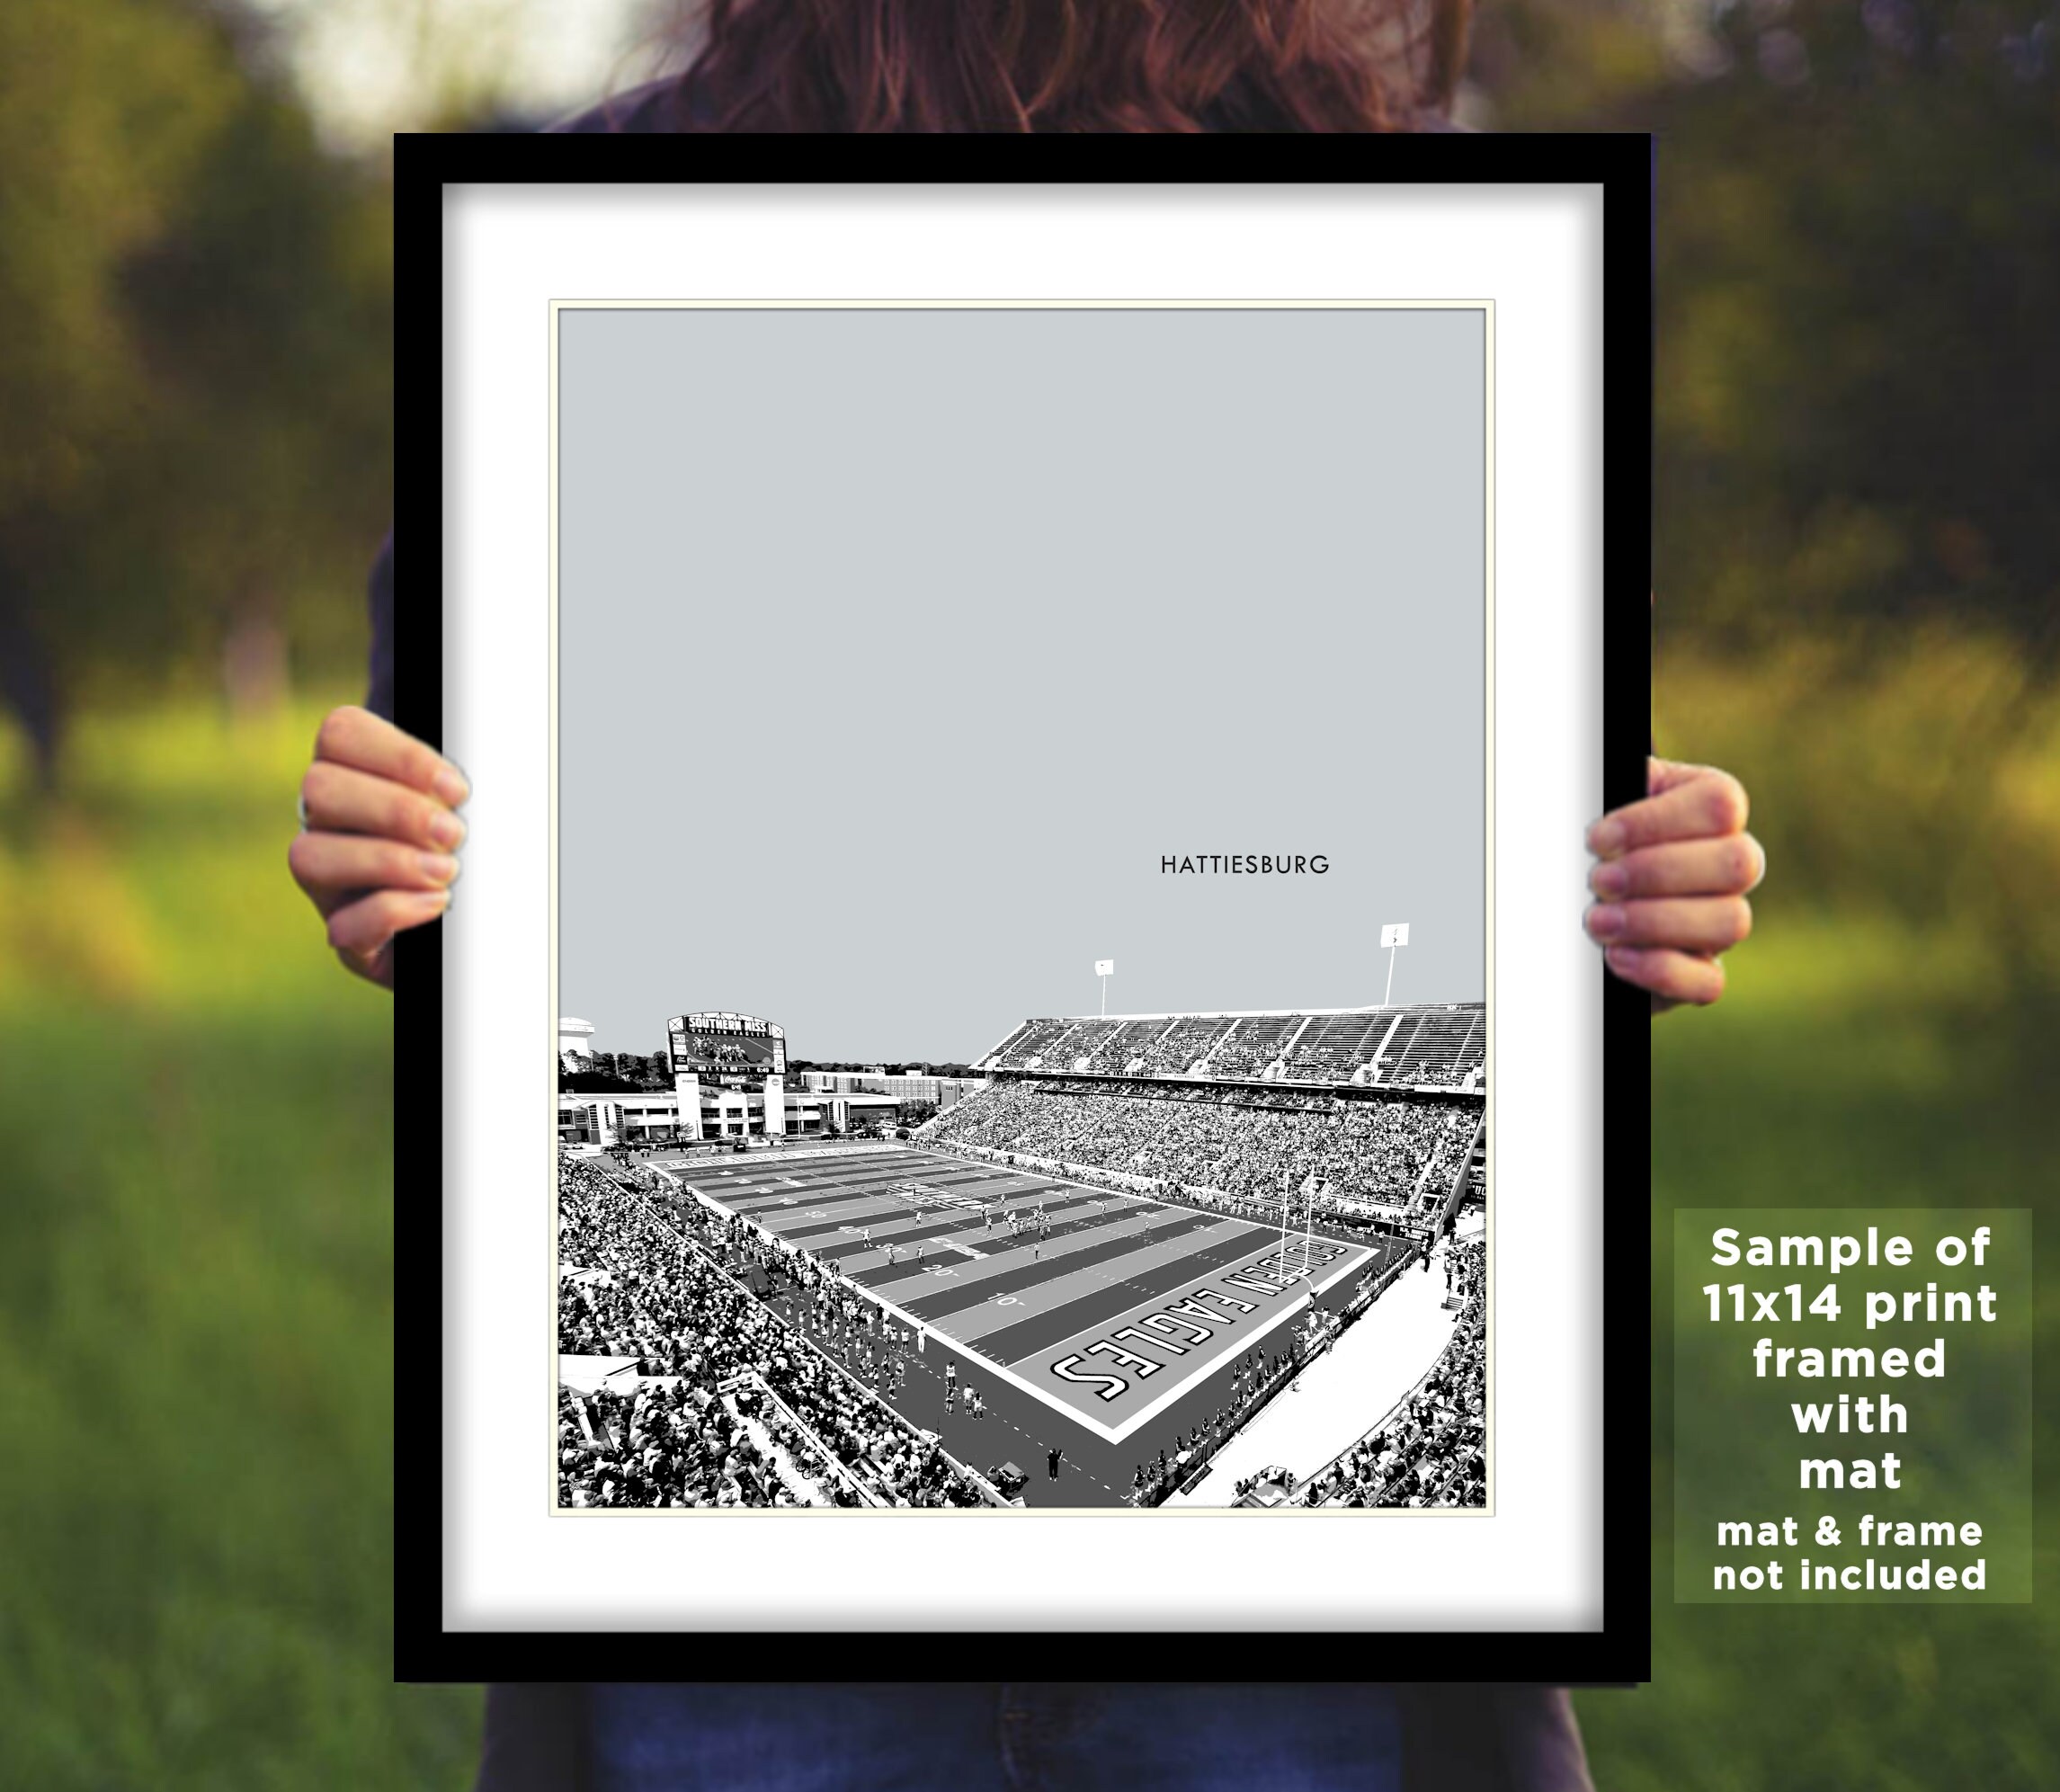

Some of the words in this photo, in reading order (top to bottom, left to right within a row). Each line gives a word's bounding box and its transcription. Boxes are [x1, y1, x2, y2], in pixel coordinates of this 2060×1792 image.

[1162, 854, 1330, 874] HATTIESBURG
[689, 1018, 742, 1030] SOUTHERN
[744, 1021, 767, 1033] MISS
[922, 1264, 955, 1278] 20
[987, 1292, 1018, 1306] 10
[1049, 1288, 1261, 1404] EAGLES
